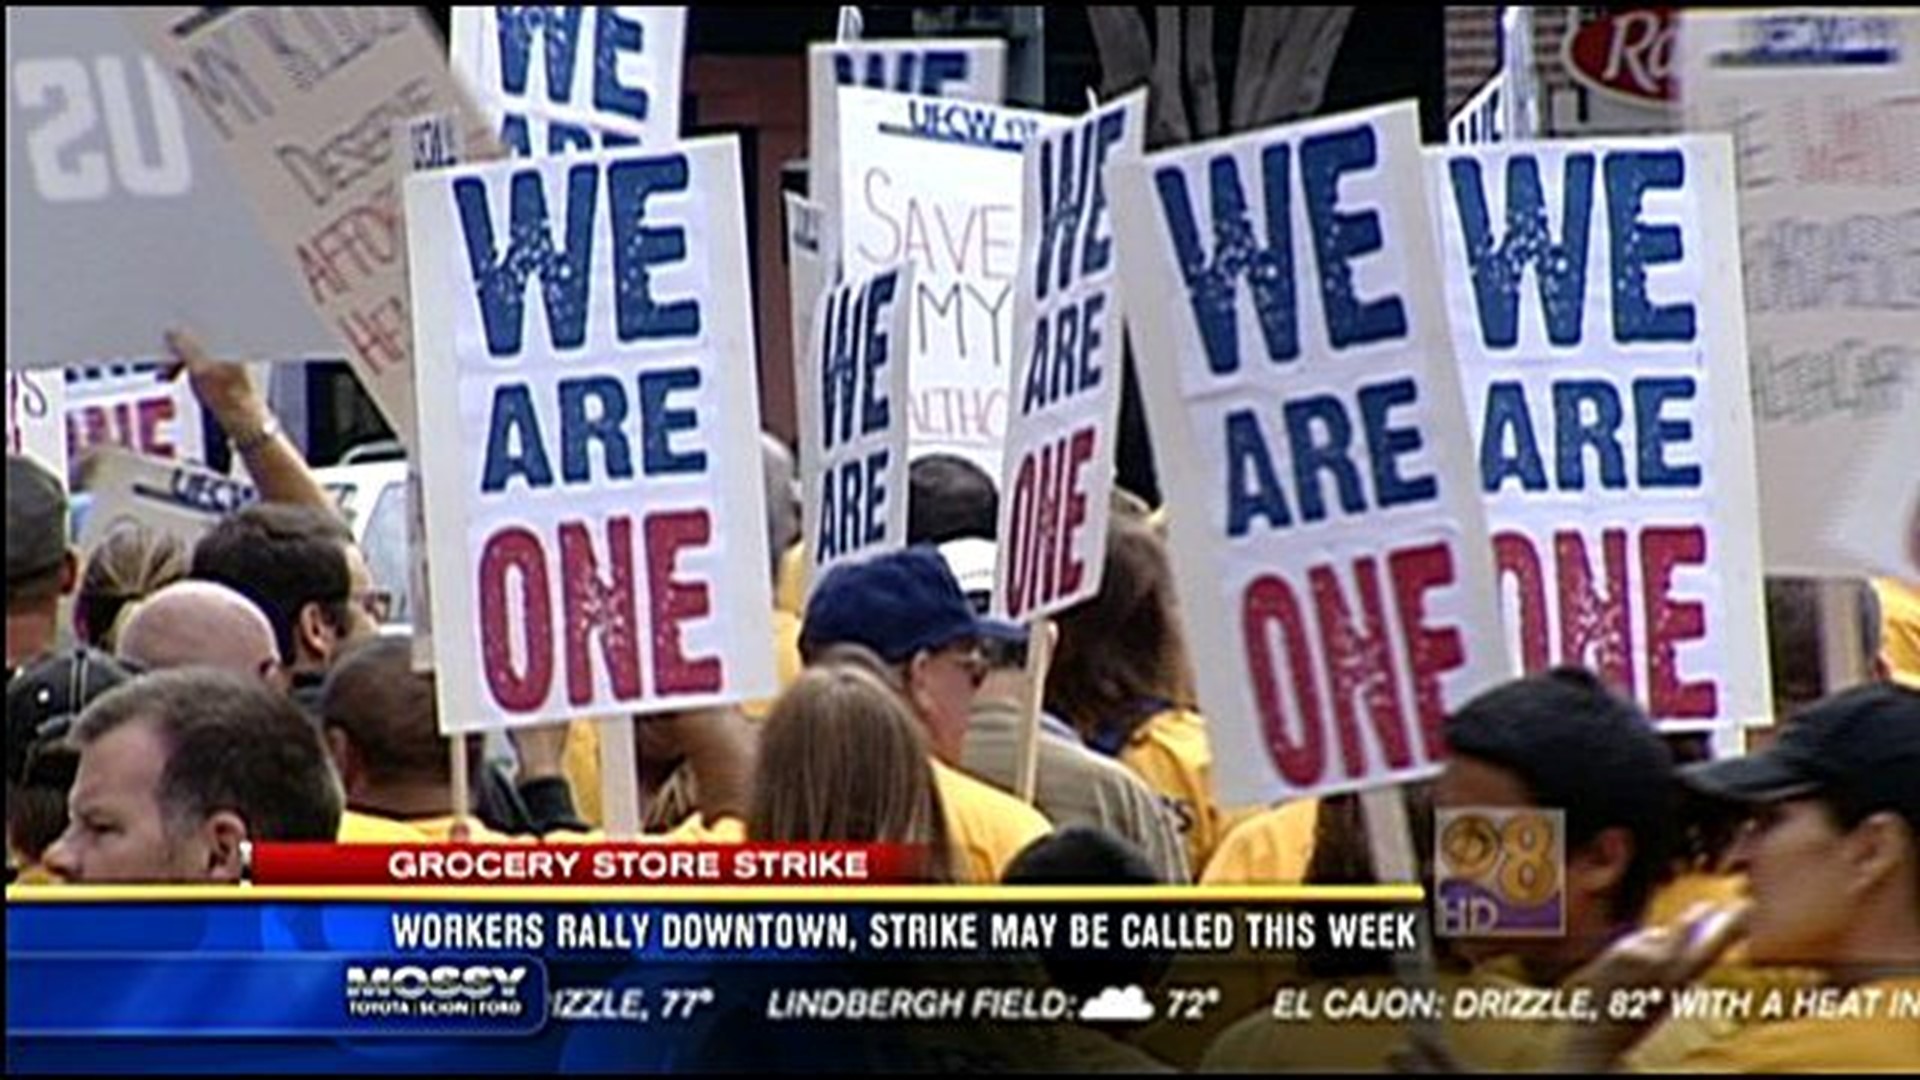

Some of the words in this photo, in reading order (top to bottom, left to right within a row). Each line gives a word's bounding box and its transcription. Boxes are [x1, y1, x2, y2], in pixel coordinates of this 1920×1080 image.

[453, 153, 700, 355] WE
[857, 166, 1015, 280] SAVE
[1035, 106, 1127, 302] WE
[1154, 123, 1408, 376] WE
[1449, 149, 1698, 348] WE
[823, 269, 899, 450] WE
[916, 281, 1012, 366] MY
[1021, 293, 1106, 416] ARE
[481, 366, 709, 494] ARE
[817, 449, 890, 566] ARE
[1225, 378, 1437, 537] ARE
[1479, 376, 1702, 492] ARE
[479, 508, 723, 714] ONE
[1005, 426, 1096, 620] ONE
[1242, 541, 1466, 789] ONE
